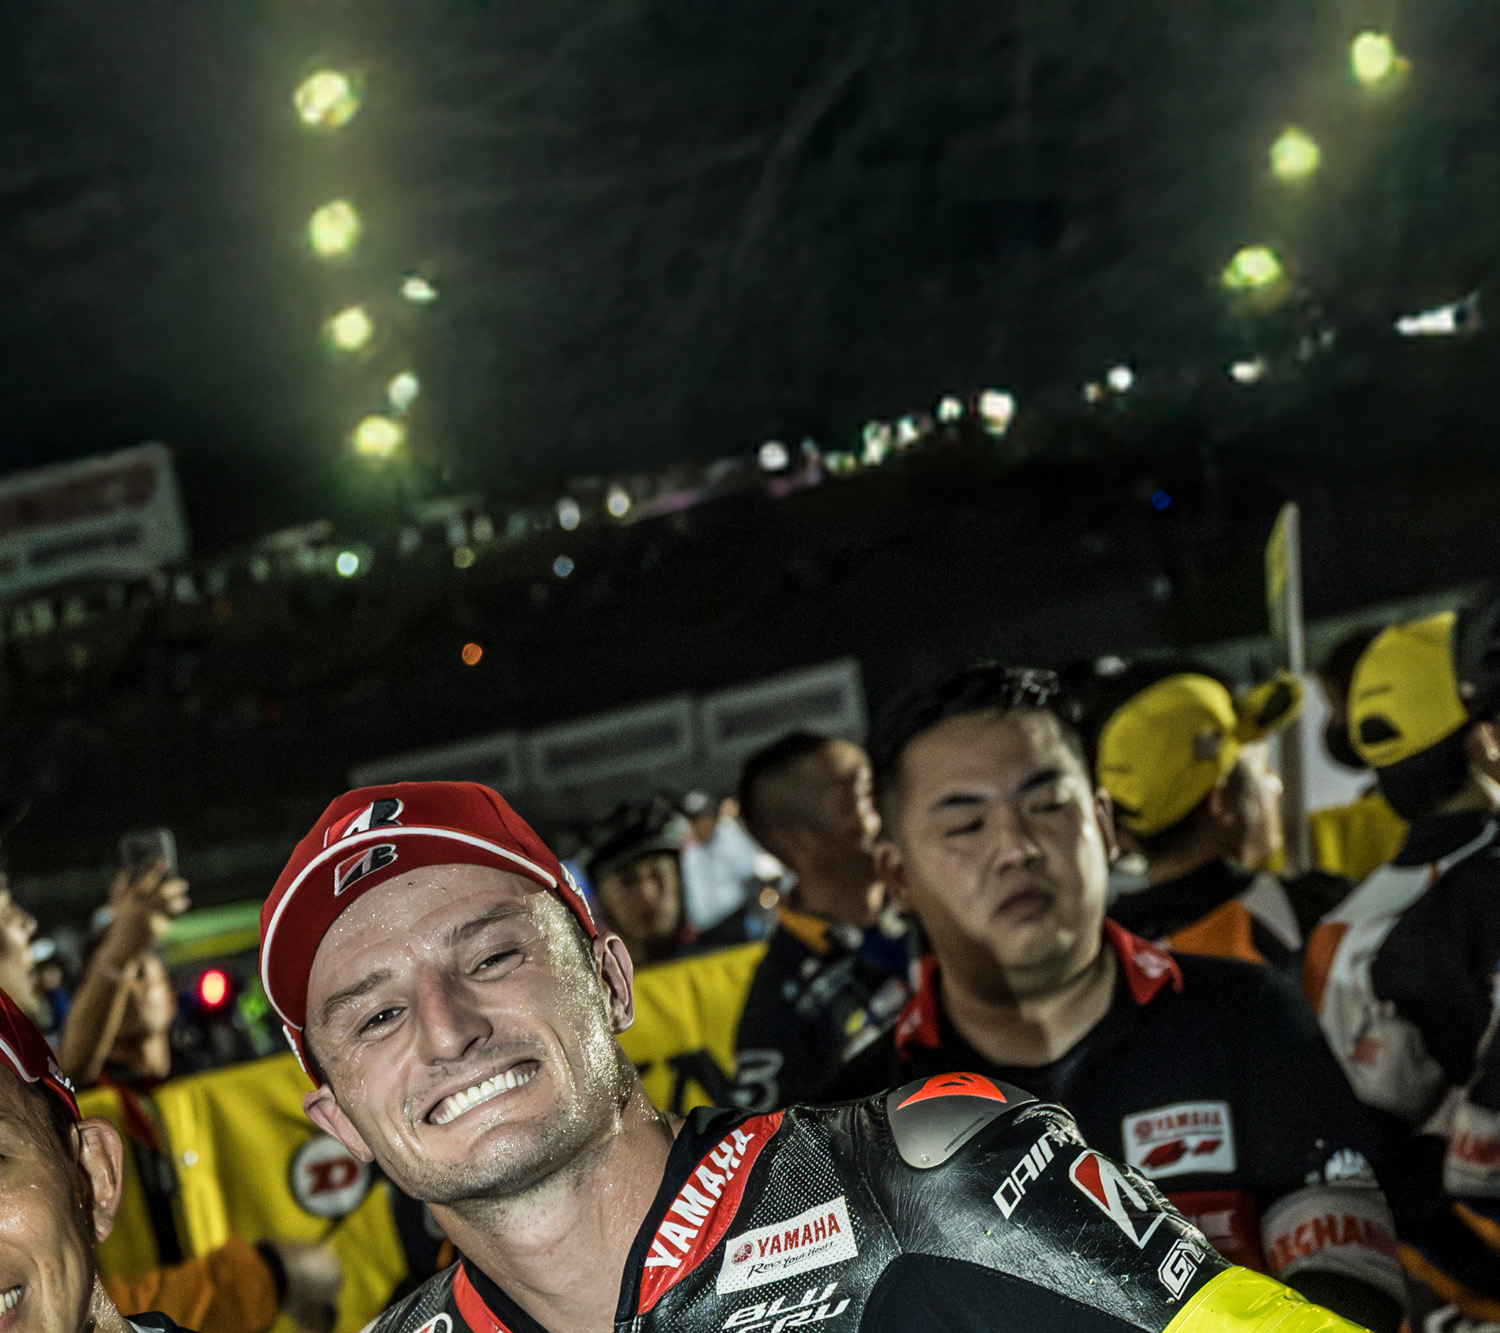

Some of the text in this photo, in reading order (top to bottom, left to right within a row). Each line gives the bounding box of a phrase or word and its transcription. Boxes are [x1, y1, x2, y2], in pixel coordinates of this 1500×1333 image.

[645, 1128, 755, 1269] YAMAHA
[992, 1131, 1054, 1219] DAIN
[757, 1213, 841, 1257] YAMAHA
[747, 1242, 837, 1279] Revs Your Heart
[722, 1282, 838, 1330] BLU
